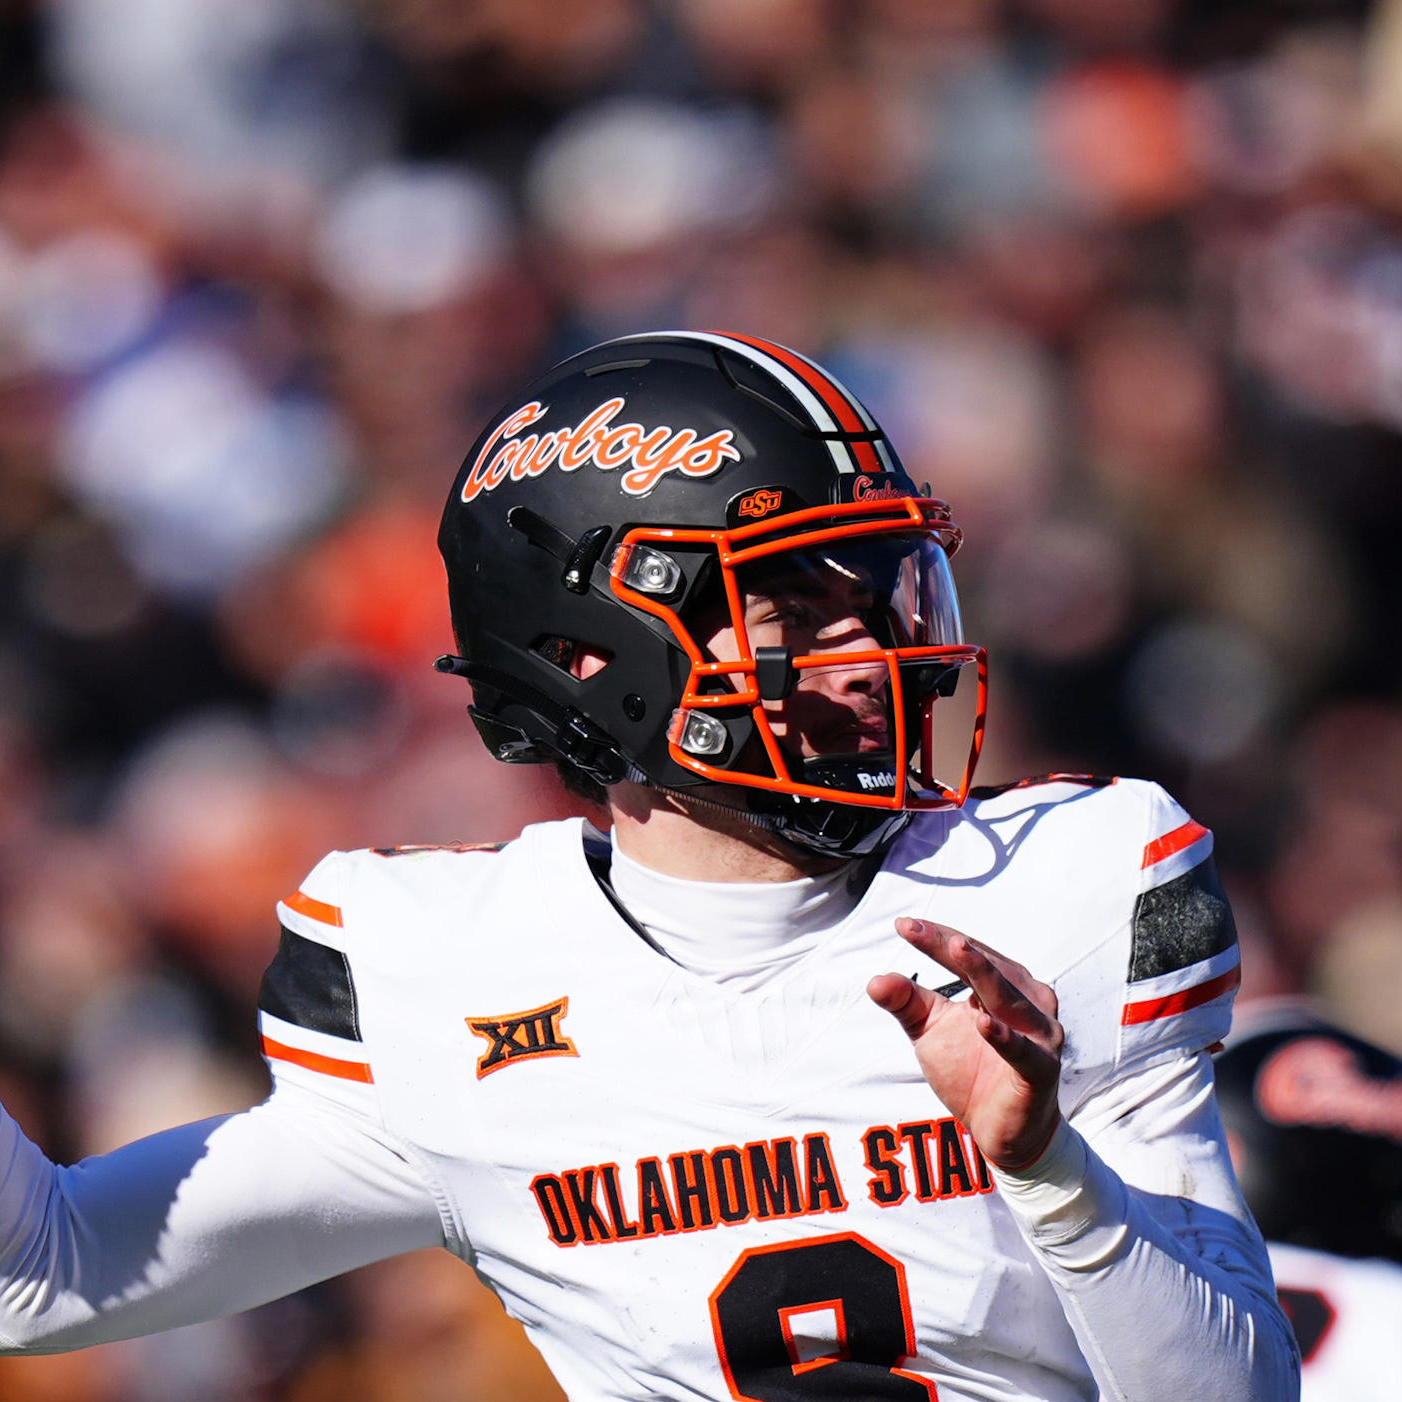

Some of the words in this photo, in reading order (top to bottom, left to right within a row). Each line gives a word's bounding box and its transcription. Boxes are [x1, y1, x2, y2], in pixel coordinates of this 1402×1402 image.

[461, 397, 741, 503] Cowboys
[738, 489, 782, 517] OSU
[856, 772, 896, 790] Ridd
[467, 999, 576, 1076] XII
[529, 1132, 848, 1247] OKLAHOMA
